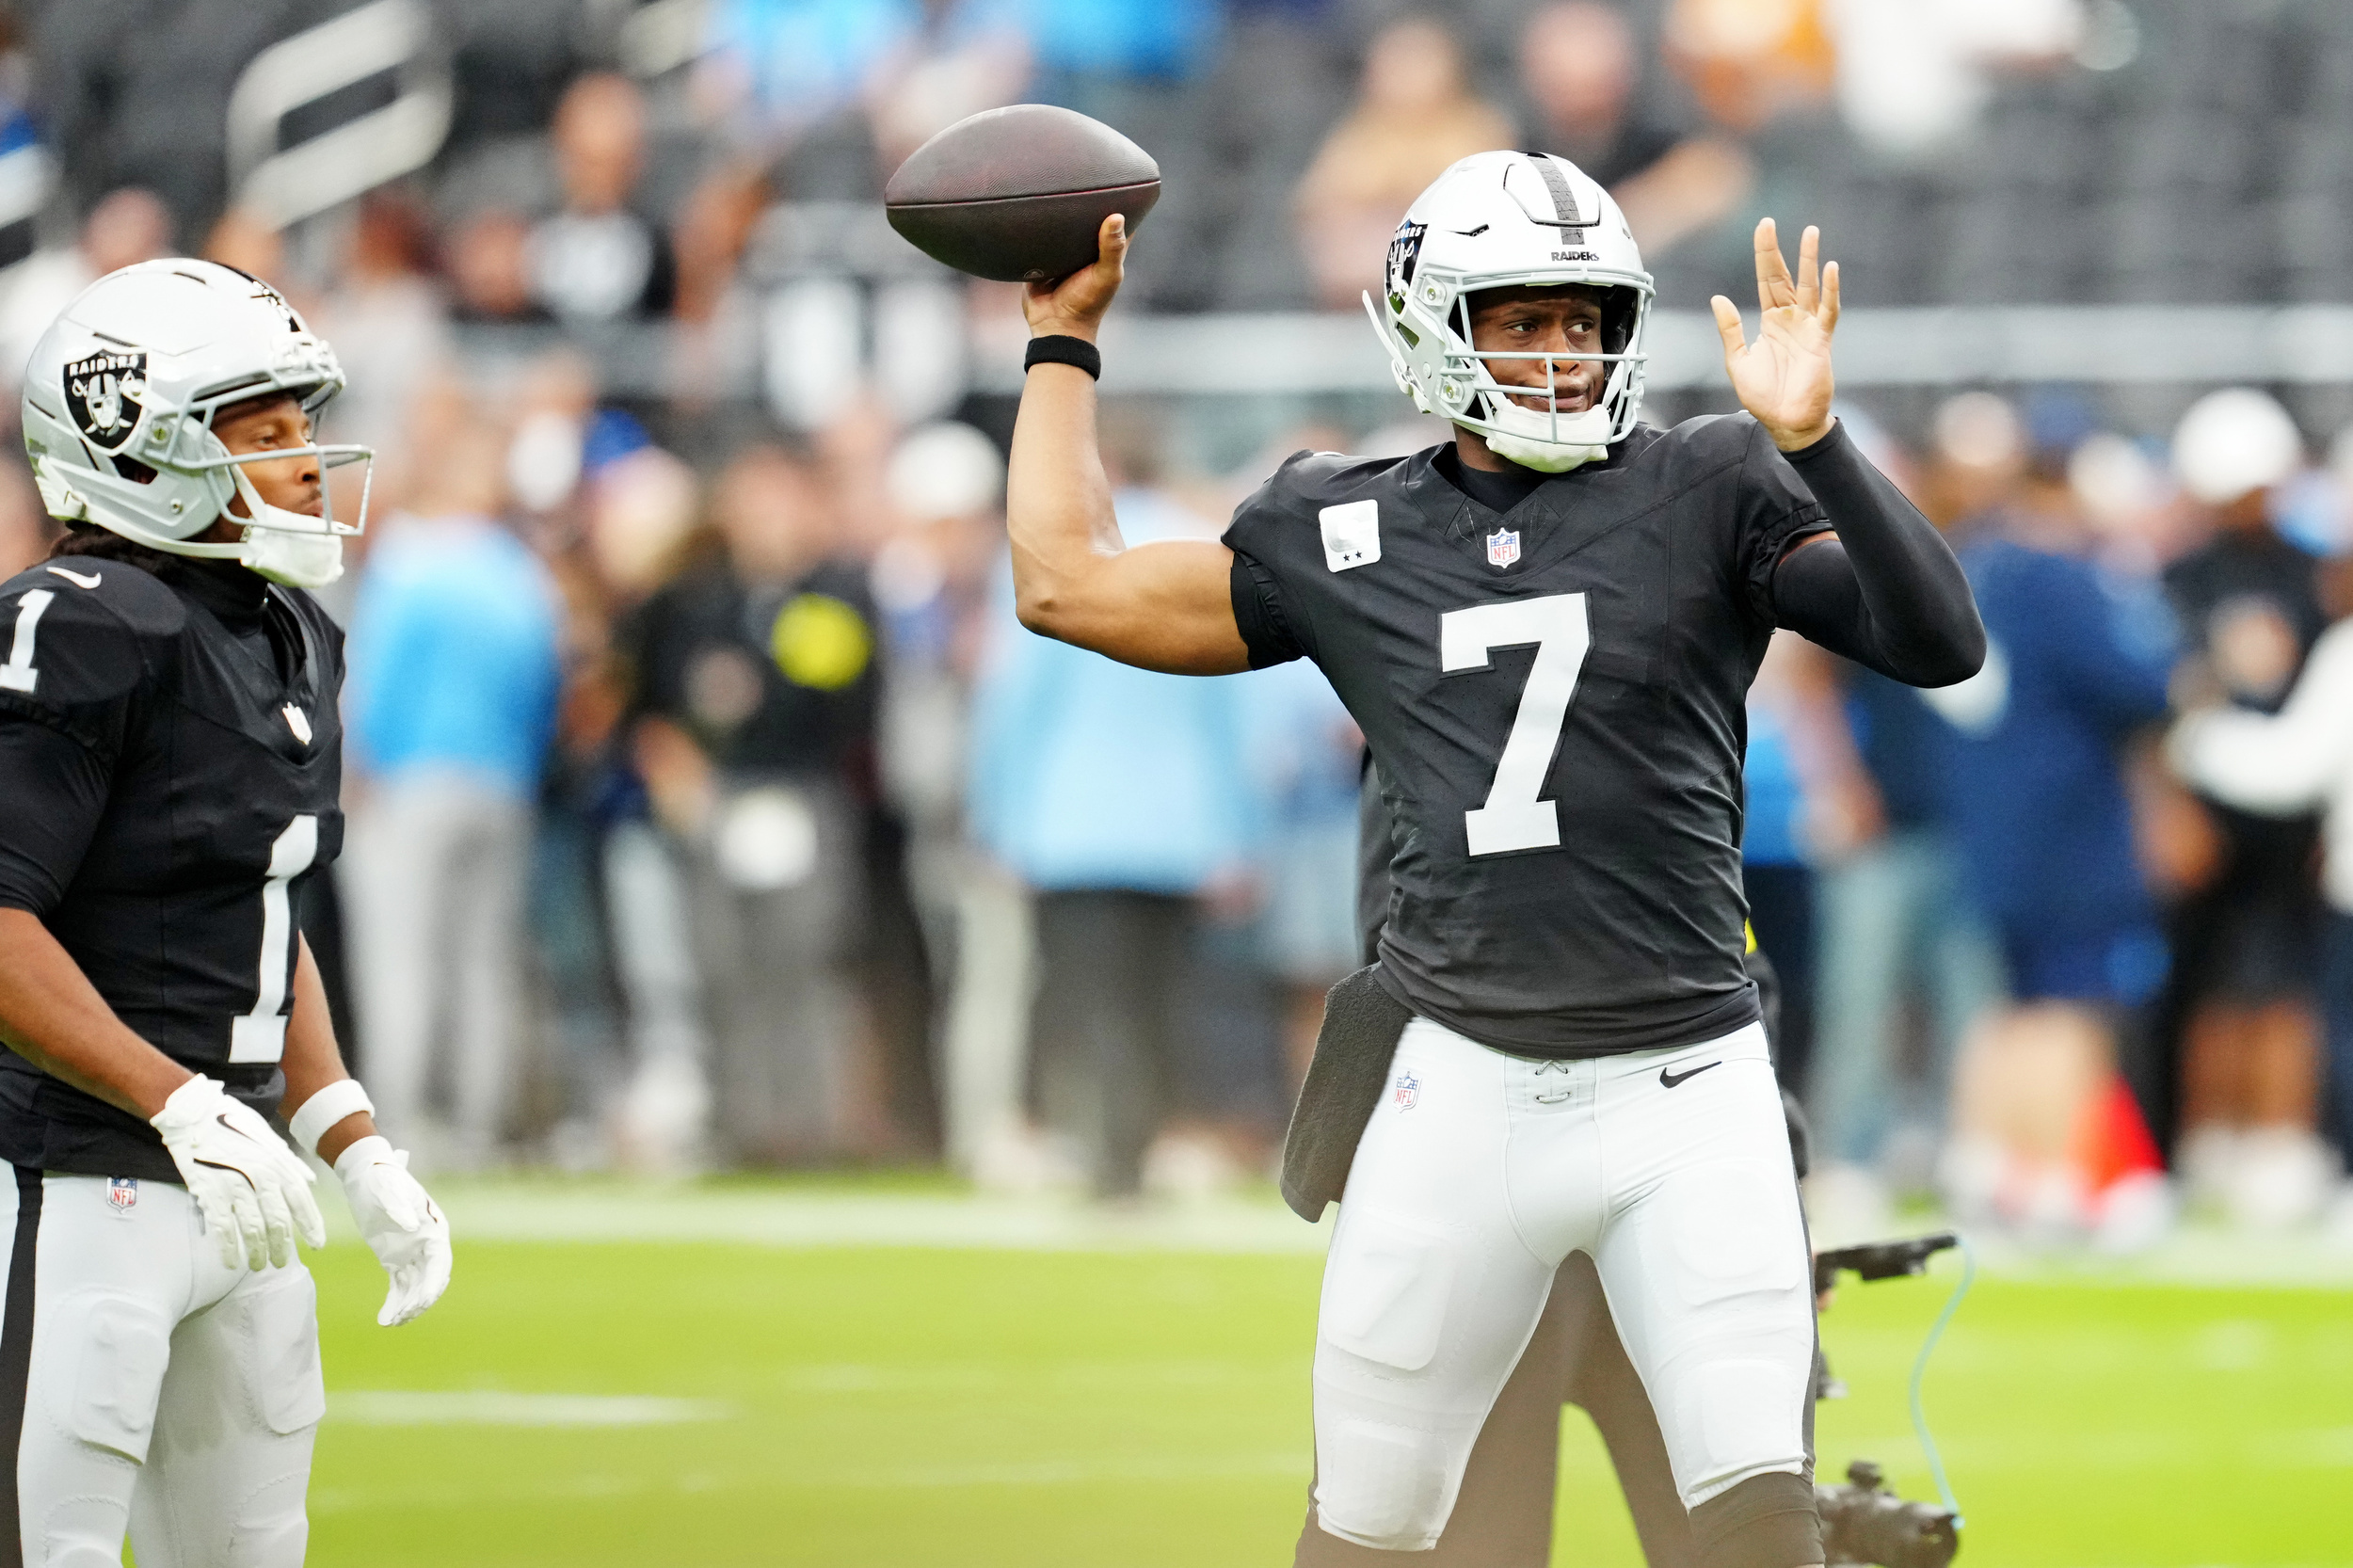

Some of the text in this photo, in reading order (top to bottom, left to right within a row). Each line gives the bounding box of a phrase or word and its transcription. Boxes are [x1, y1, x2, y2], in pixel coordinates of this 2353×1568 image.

[1551, 250, 1599, 262] RAIDERS
[69, 354, 139, 376] RAIDERS
[1494, 545, 1514, 560] NFL
[0, 589, 54, 693] 1
[1441, 592, 1590, 856] 7
[228, 815, 318, 1064] 1
[1396, 1089, 1412, 1104] NFL
[113, 1189, 134, 1205] NFL
